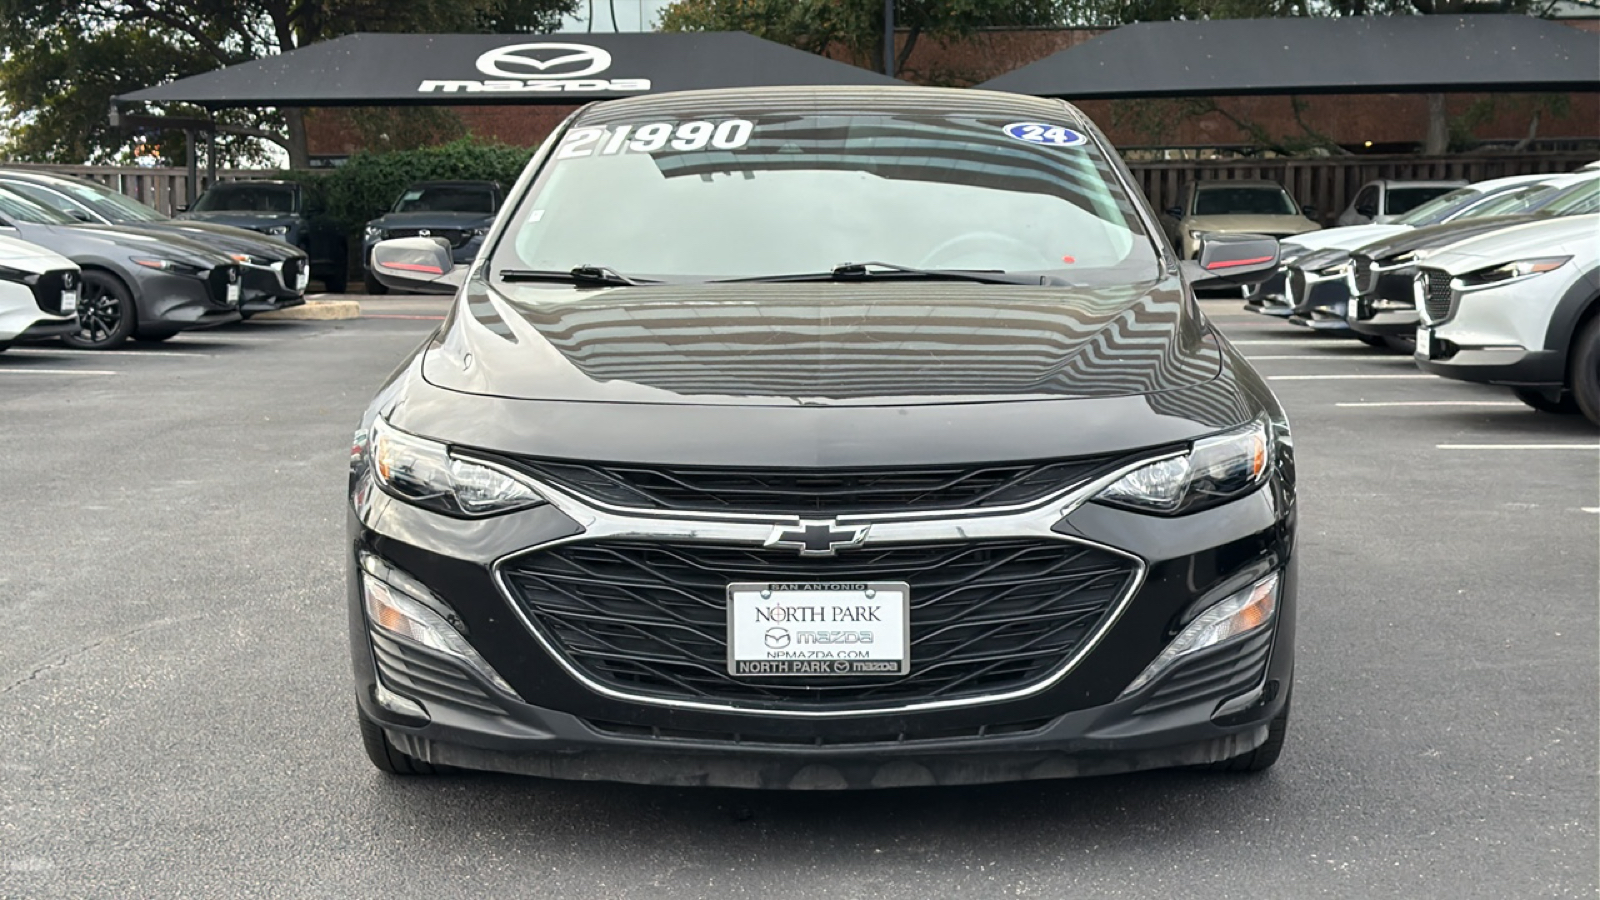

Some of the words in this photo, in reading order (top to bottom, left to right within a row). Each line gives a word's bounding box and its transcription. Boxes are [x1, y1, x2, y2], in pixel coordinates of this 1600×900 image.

[418, 79, 651, 92] mazda
[557, 119, 756, 160] 21990
[1022, 126, 1067, 143] 24
[755, 604, 825, 624] NORTH
[832, 606, 881, 622] PARK
[796, 630, 874, 644] mazda
[739, 661, 788, 673] NORTH
[793, 661, 830, 673] PARK
[853, 661, 898, 671] mazda
